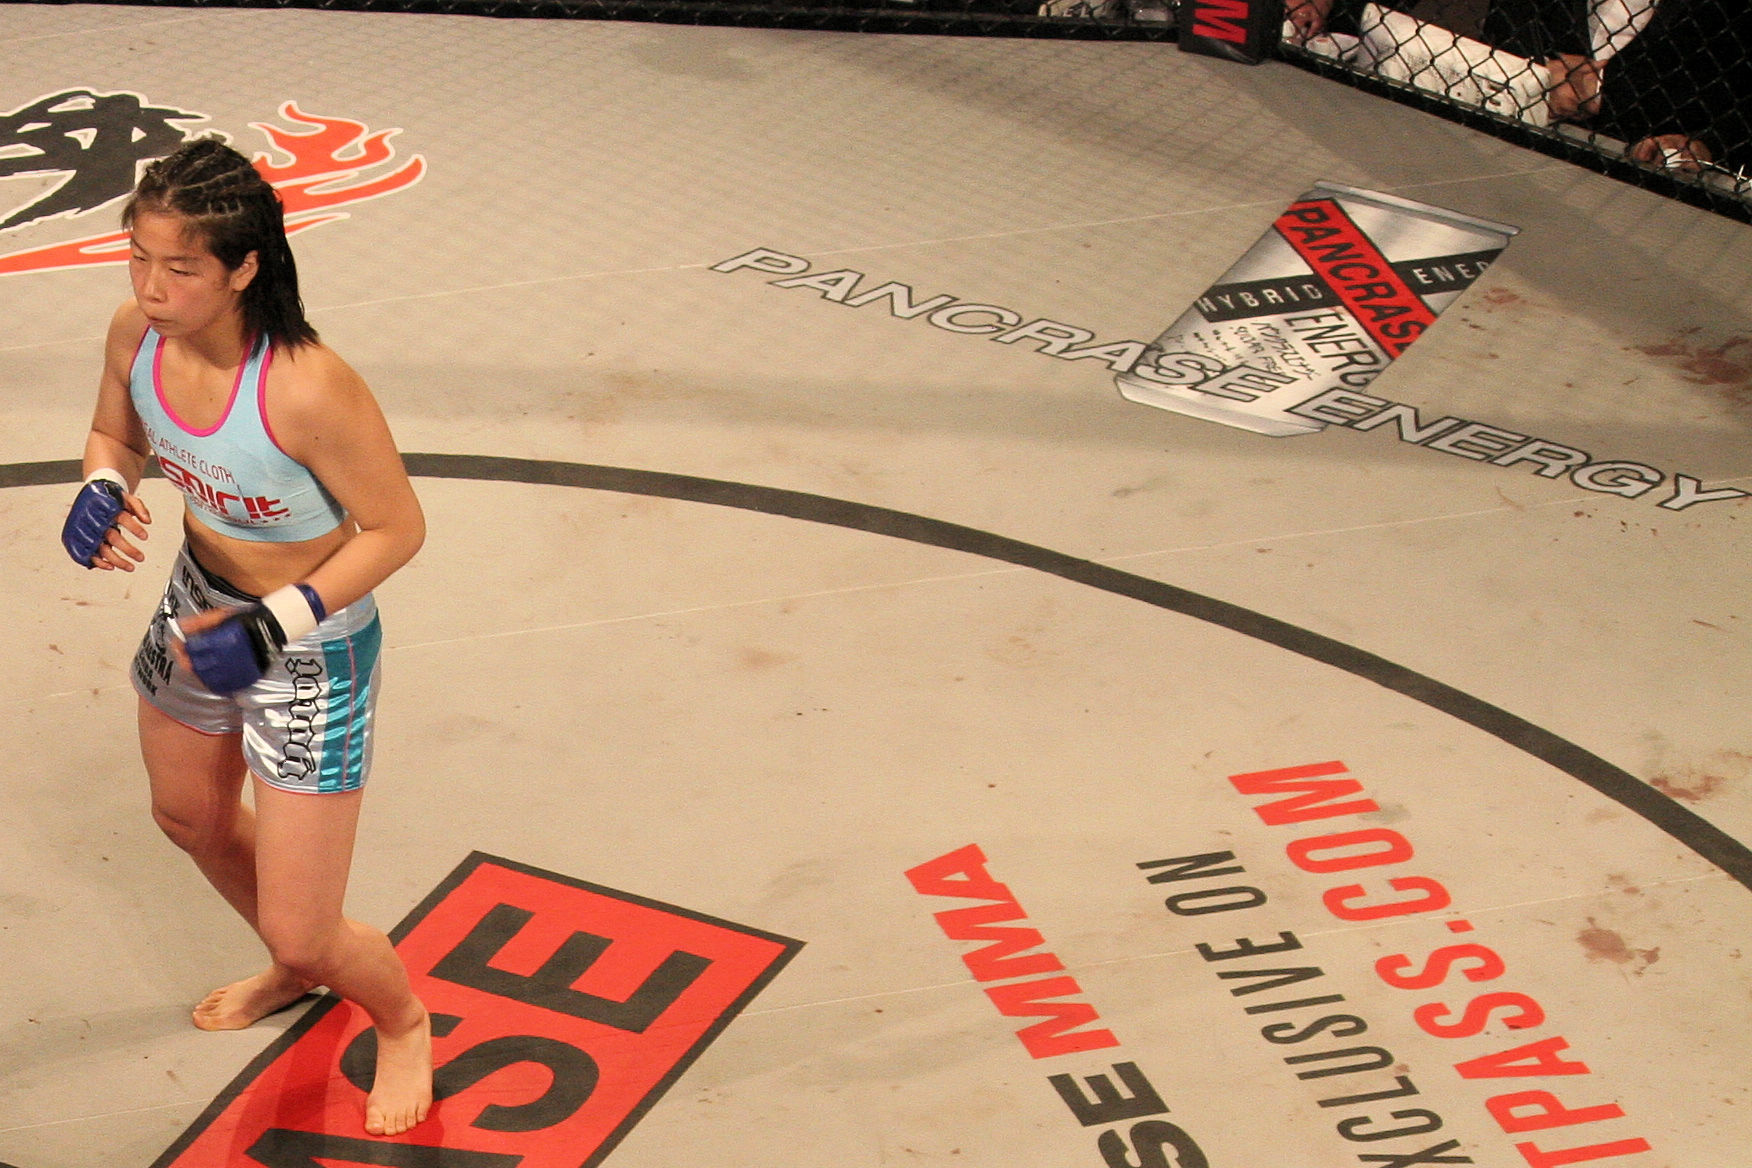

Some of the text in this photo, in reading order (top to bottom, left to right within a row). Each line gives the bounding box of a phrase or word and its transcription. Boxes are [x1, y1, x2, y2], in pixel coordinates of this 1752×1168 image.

[1285, 202, 1428, 352] PANCRAS
[709, 246, 1299, 403] PANCRASE
[1284, 386, 1750, 511] ENERGY
[903, 843, 1122, 1060] MMA
[1136, 850, 1268, 917] ON
